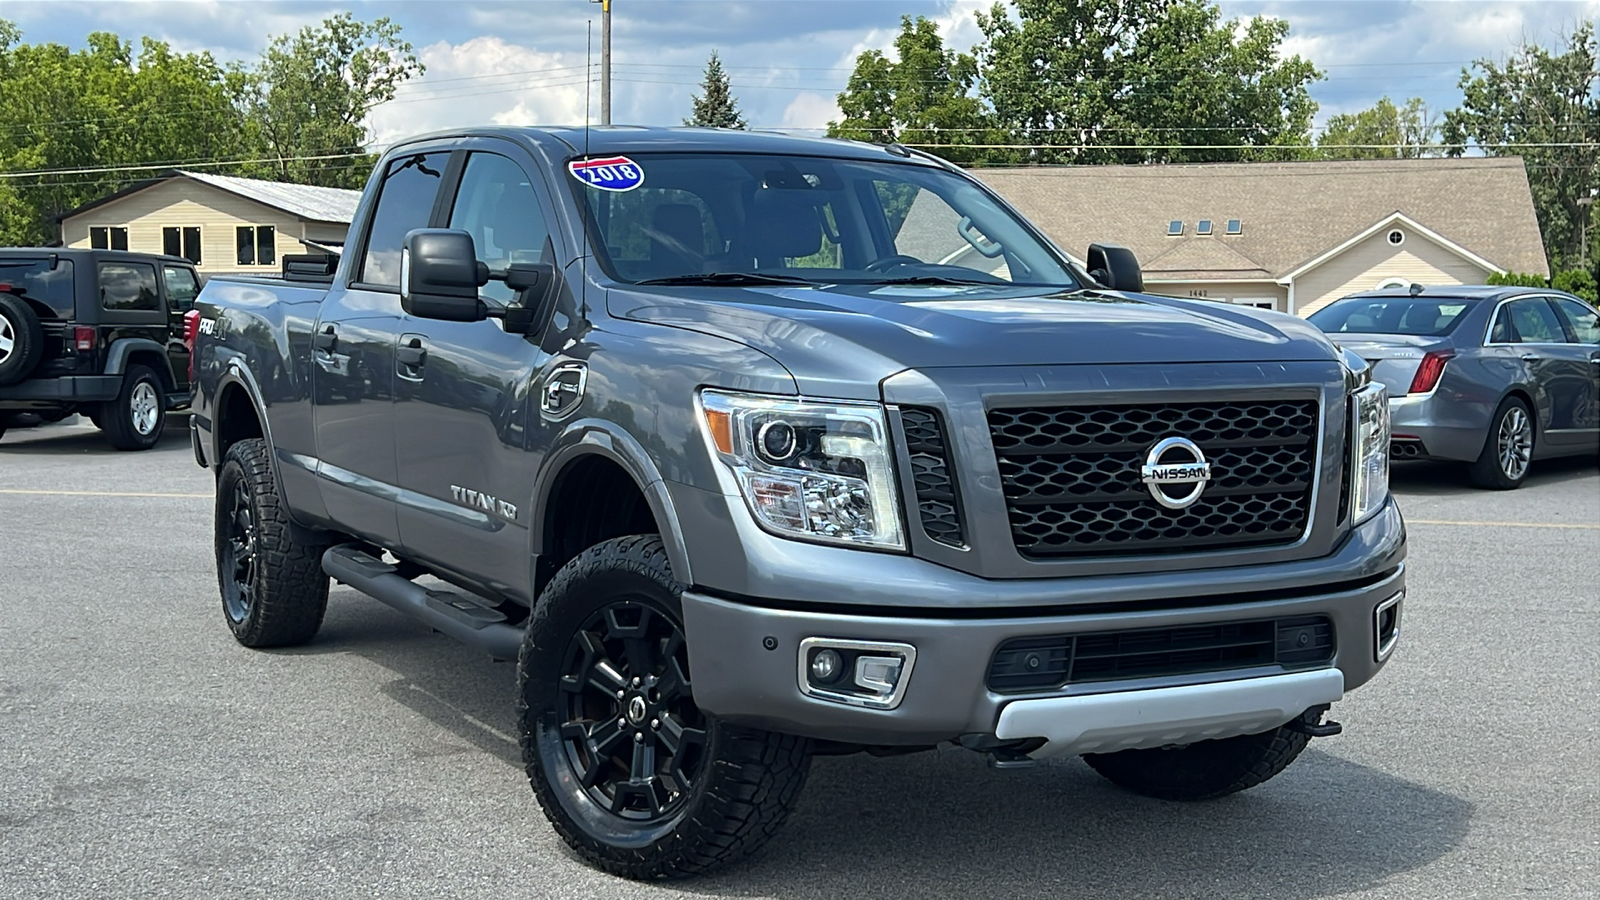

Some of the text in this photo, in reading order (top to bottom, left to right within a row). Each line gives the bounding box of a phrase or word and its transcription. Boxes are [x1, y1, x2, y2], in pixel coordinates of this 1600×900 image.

[582, 165, 638, 183] 2018
[1152, 467, 1206, 480] NISSAN
[450, 484, 496, 512] TITAN
